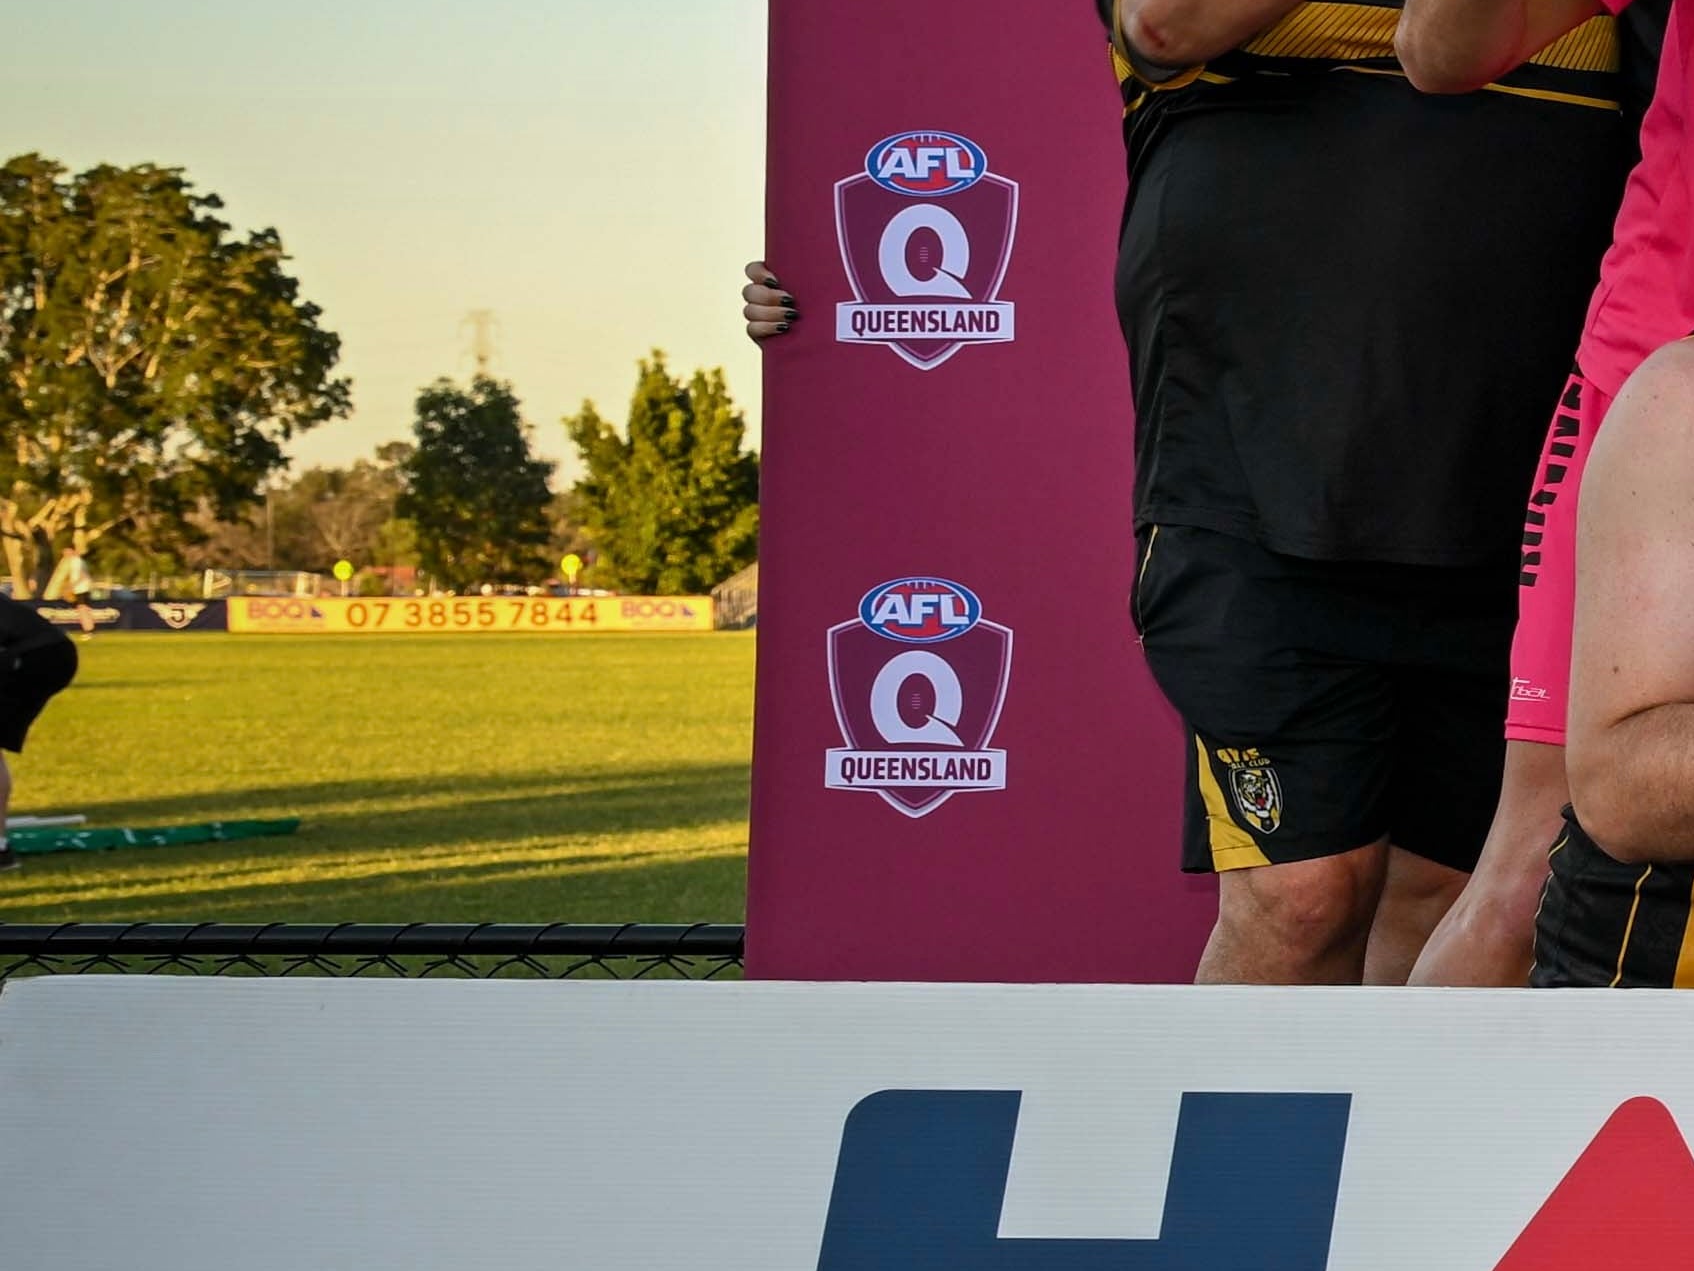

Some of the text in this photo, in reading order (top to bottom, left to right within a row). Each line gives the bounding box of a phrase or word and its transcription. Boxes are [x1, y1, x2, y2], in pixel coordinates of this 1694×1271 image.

[877, 145, 975, 178] AFL
[879, 203, 971, 298] Q
[851, 310, 1001, 335] QUEENSLAND
[346, 602, 389, 628] 07
[403, 602, 496, 628] 3855
[510, 602, 598, 627] 7844
[870, 590, 970, 627] AFL
[870, 649, 964, 746] Q
[839, 756, 991, 782] QUEENSLAND
